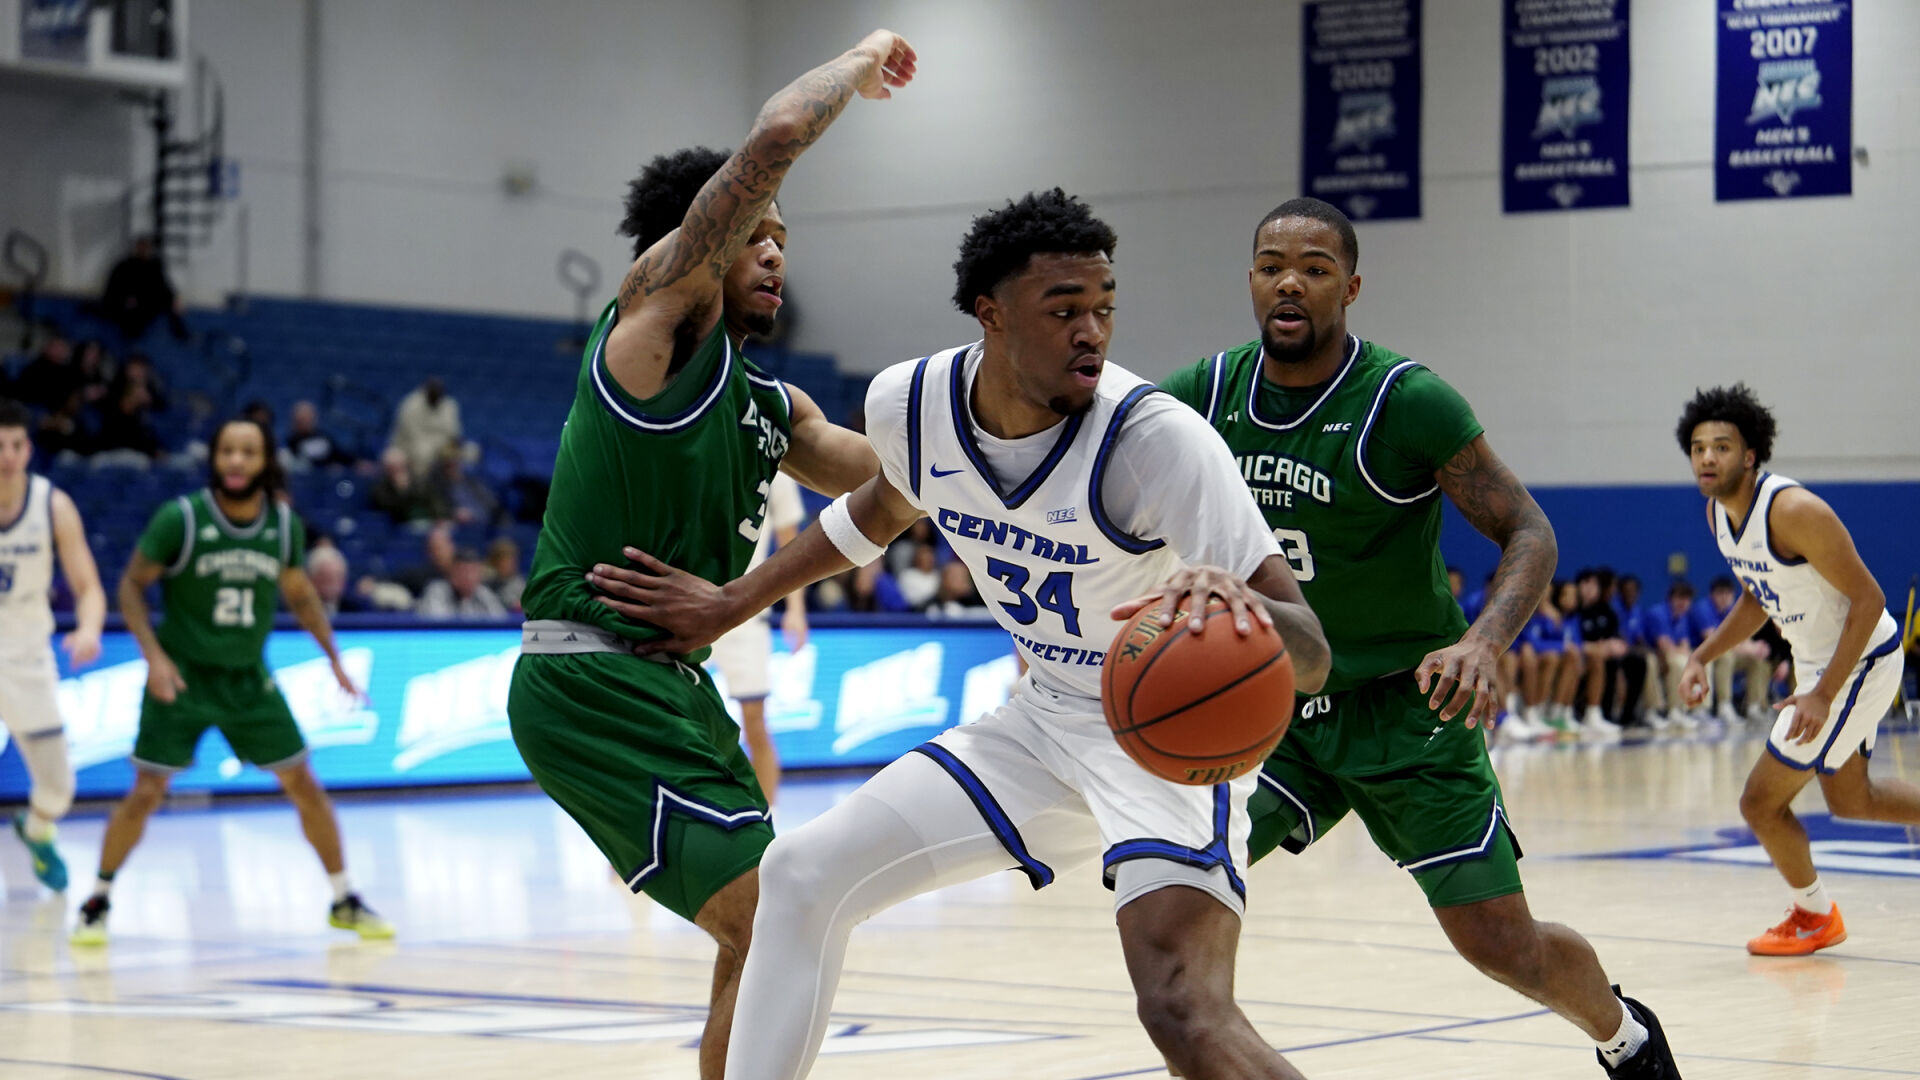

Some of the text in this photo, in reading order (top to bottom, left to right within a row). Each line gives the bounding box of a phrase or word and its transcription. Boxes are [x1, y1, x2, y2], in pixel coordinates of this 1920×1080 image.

[1750, 25, 1818, 59] 2007
[1534, 45, 1599, 75] 2002
[1755, 126, 1810, 146] MEN'S
[1728, 145, 1836, 168] BASKETBALL
[1322, 422, 1352, 433] NEC
[1250, 486, 1293, 508] TATE
[1046, 506, 1077, 524] NEC
[938, 506, 1100, 565] CENTRAL
[1726, 556, 1774, 573] ENTRAL
[213, 586, 256, 628] 21
[986, 554, 1083, 638] 34
[1012, 632, 1109, 667] NECTIC
